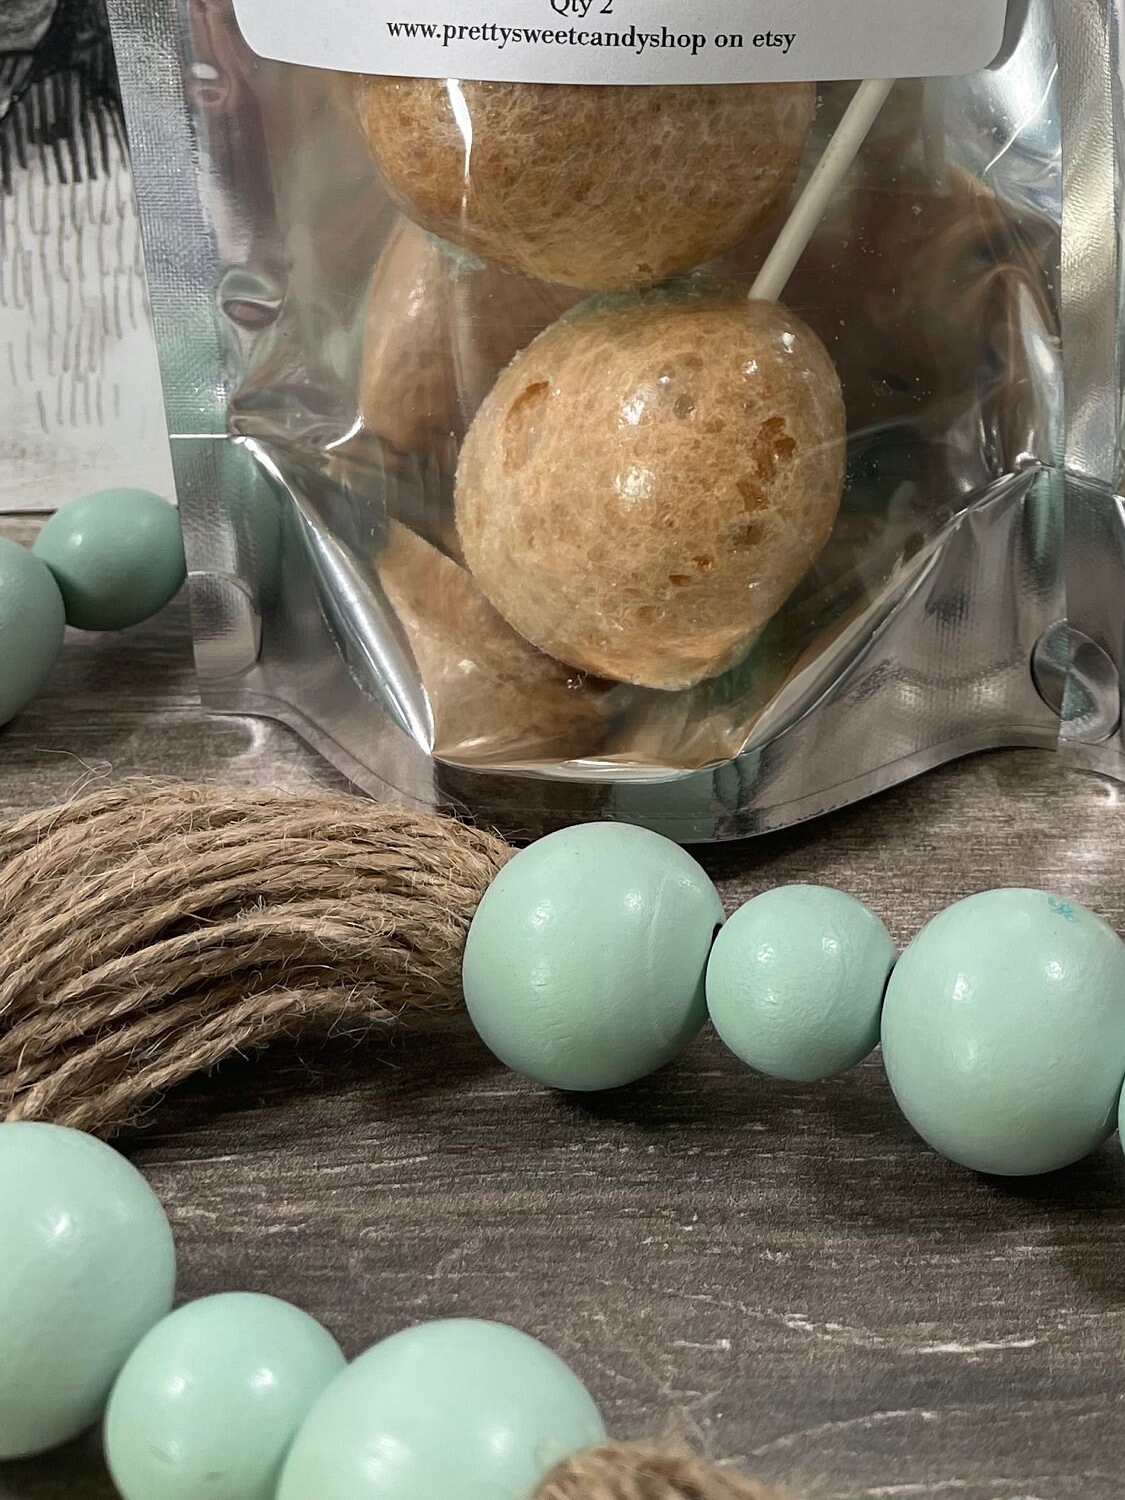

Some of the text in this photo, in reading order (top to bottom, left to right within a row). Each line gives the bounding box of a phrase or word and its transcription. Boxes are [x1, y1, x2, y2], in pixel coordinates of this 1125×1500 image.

[387, 22, 797, 55] www.prettysweetcandyshop on etsy
